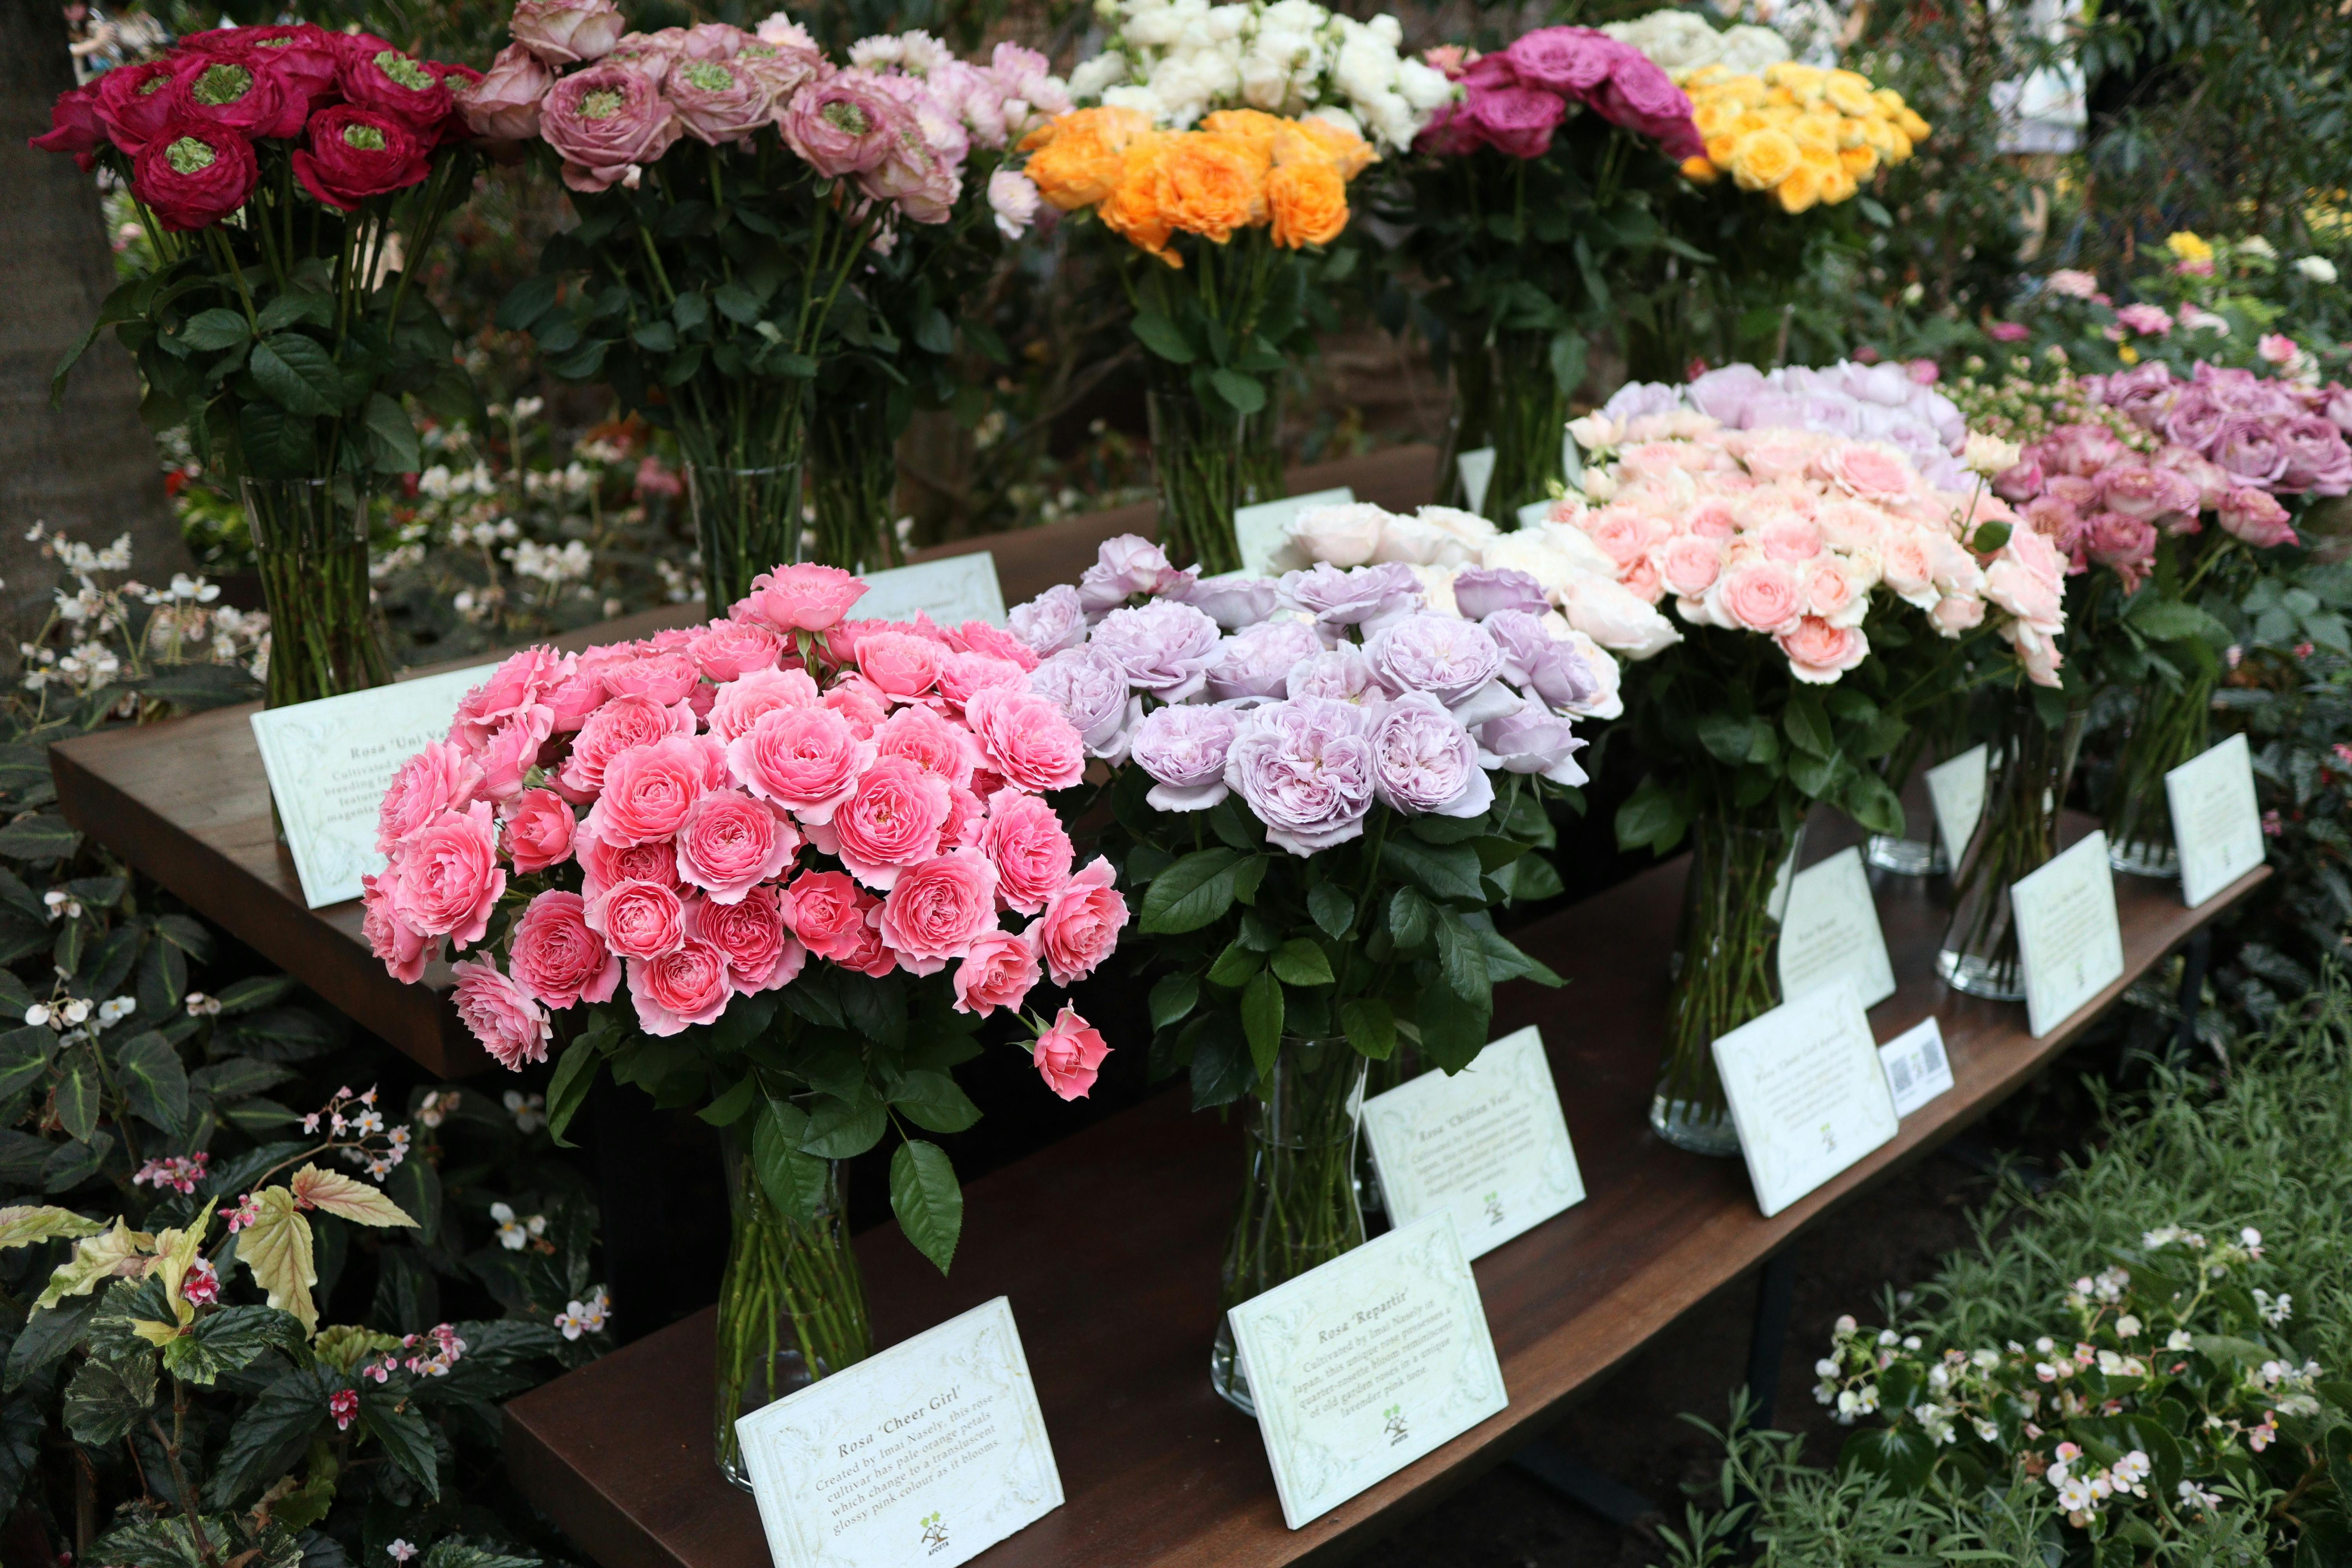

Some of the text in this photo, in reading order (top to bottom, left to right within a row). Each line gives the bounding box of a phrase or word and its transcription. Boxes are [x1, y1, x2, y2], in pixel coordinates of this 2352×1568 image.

[332, 758, 391, 781] Cultivated
[350, 744, 385, 759] Rosa
[324, 780, 374, 797] breeding
[327, 804, 374, 822] magenta
[1303, 1340, 1353, 1372] Cultivated
[1355, 1336, 1367, 1347] by
[1425, 1300, 1435, 1310] in
[1319, 1287, 1408, 1344] Rosa 'Repartir'
[1325, 1363, 1344, 1377] this
[1347, 1347, 1377, 1367] unique
[1380, 1335, 1400, 1348] rose
[1402, 1311, 1444, 1340] possesses
[1299, 1320, 1454, 1410] quarter-rosette bloom reminiscent
[1310, 1405, 1320, 1418] of
[1323, 1396, 1339, 1412] old
[1341, 1380, 1374, 1405] garden
[1375, 1367, 1399, 1383] roses
[1401, 1359, 1411, 1369] in
[1420, 1338, 1450, 1358] unique
[1341, 1391, 1381, 1418] lavender
[1384, 1377, 1405, 1397] pink
[816, 1395, 993, 1491] Created by Imai Nasely, this rose
[828, 1412, 991, 1502] cultivar has pale orange petals
[838, 1384, 960, 1458] Rosa 'Cheer Girl'
[831, 1494, 866, 1517] which
[869, 1473, 906, 1497] change
[909, 1466, 920, 1475] to
[932, 1424, 995, 1463] transluscent
[833, 1440, 1001, 1536] glossy pink colour as it blooms.
